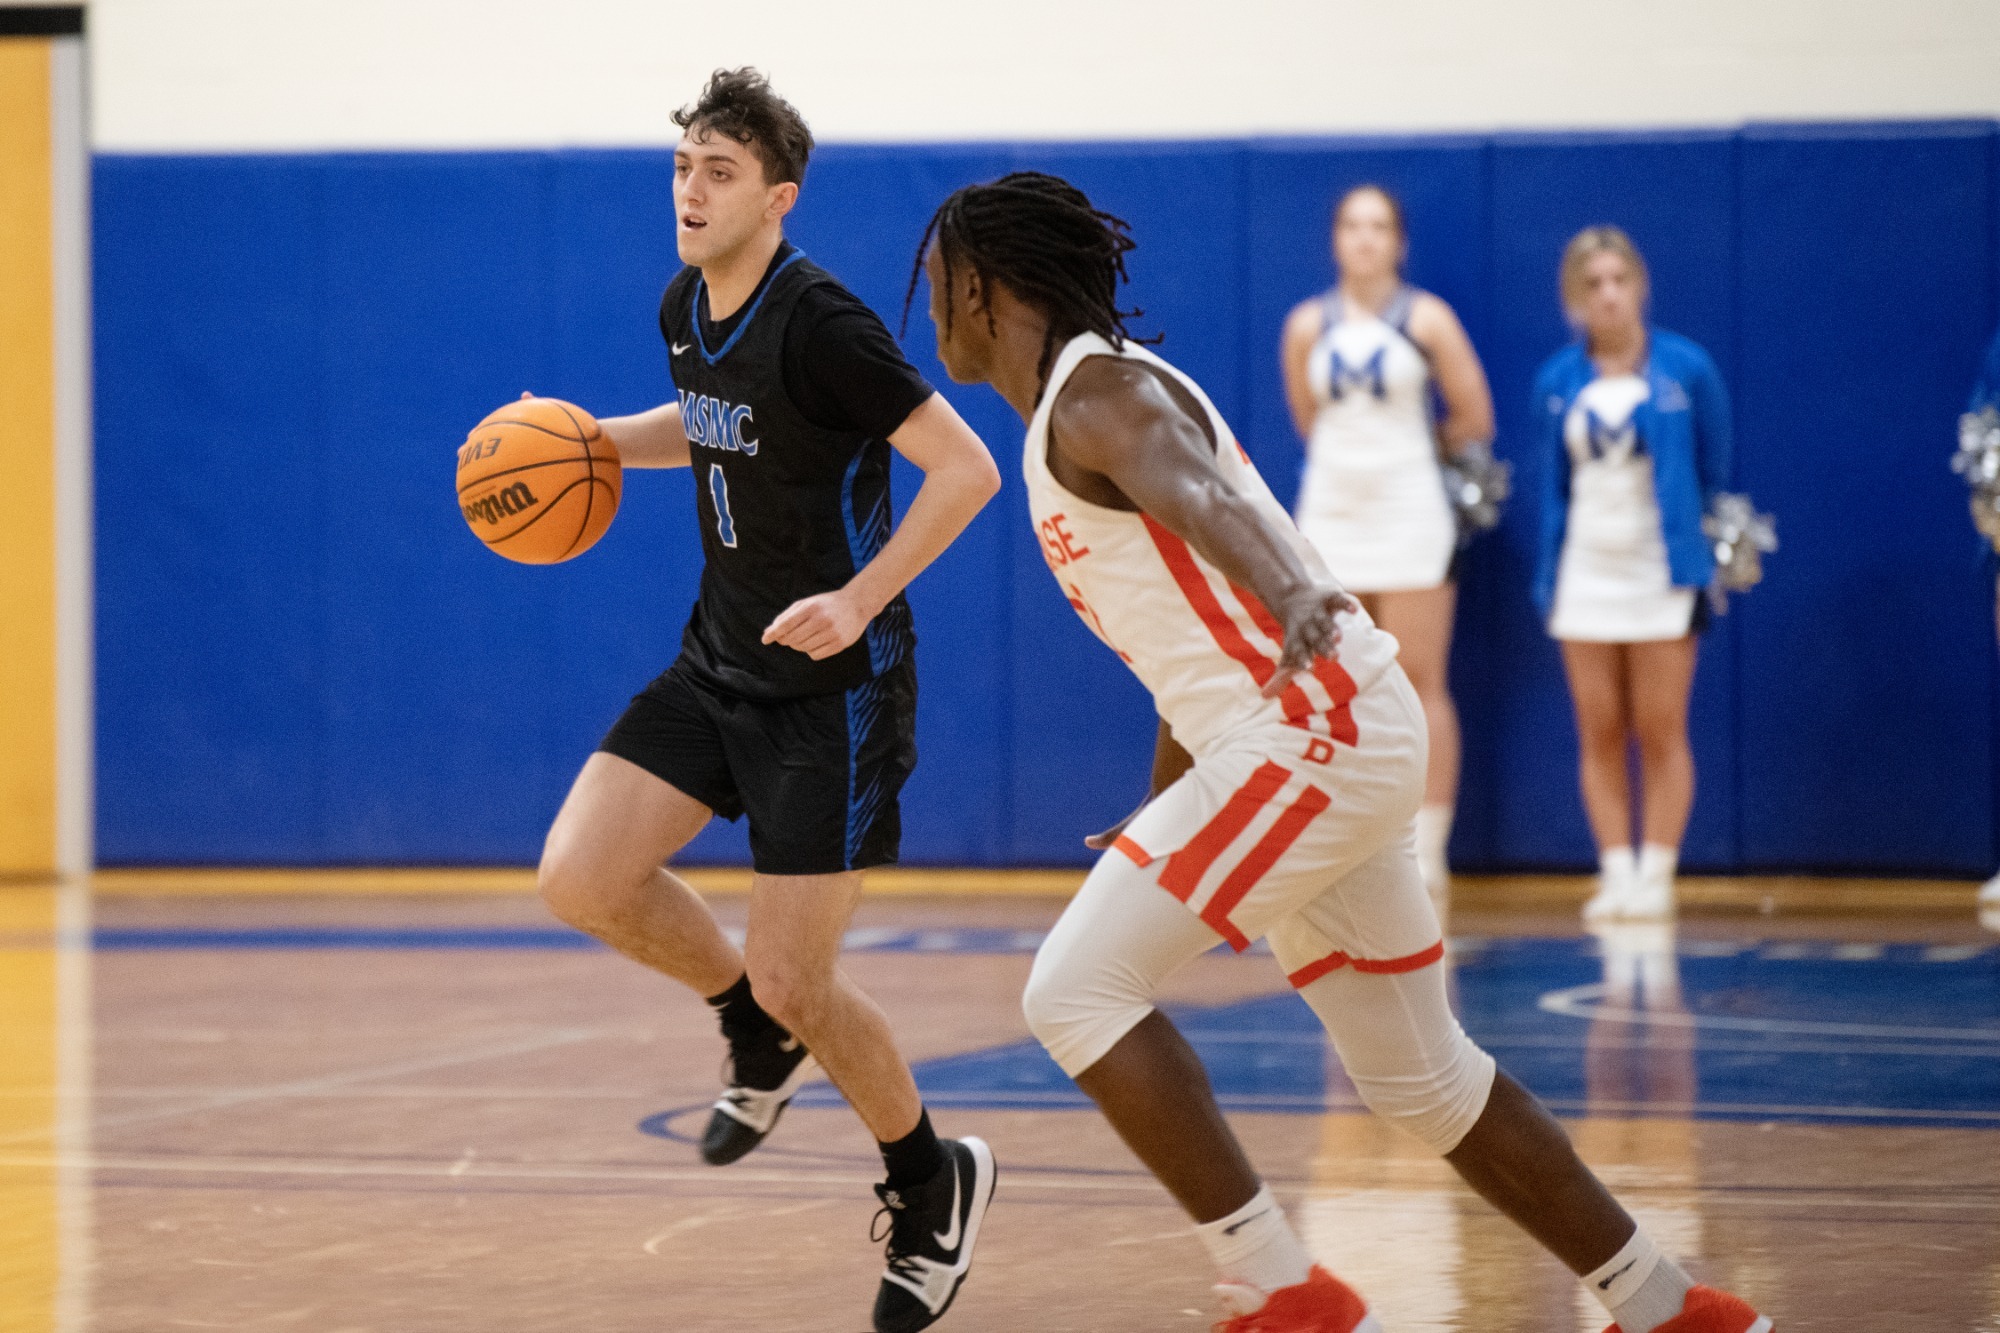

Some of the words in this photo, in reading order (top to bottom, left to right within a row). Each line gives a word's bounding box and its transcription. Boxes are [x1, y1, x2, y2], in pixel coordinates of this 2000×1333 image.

[1329, 349, 1386, 401] M
[677, 388, 759, 456] MSMC
[1585, 404, 1645, 459] M
[462, 481, 539, 525] Wilso
[709, 463, 737, 548] 1
[1037, 513, 1090, 571] SE
